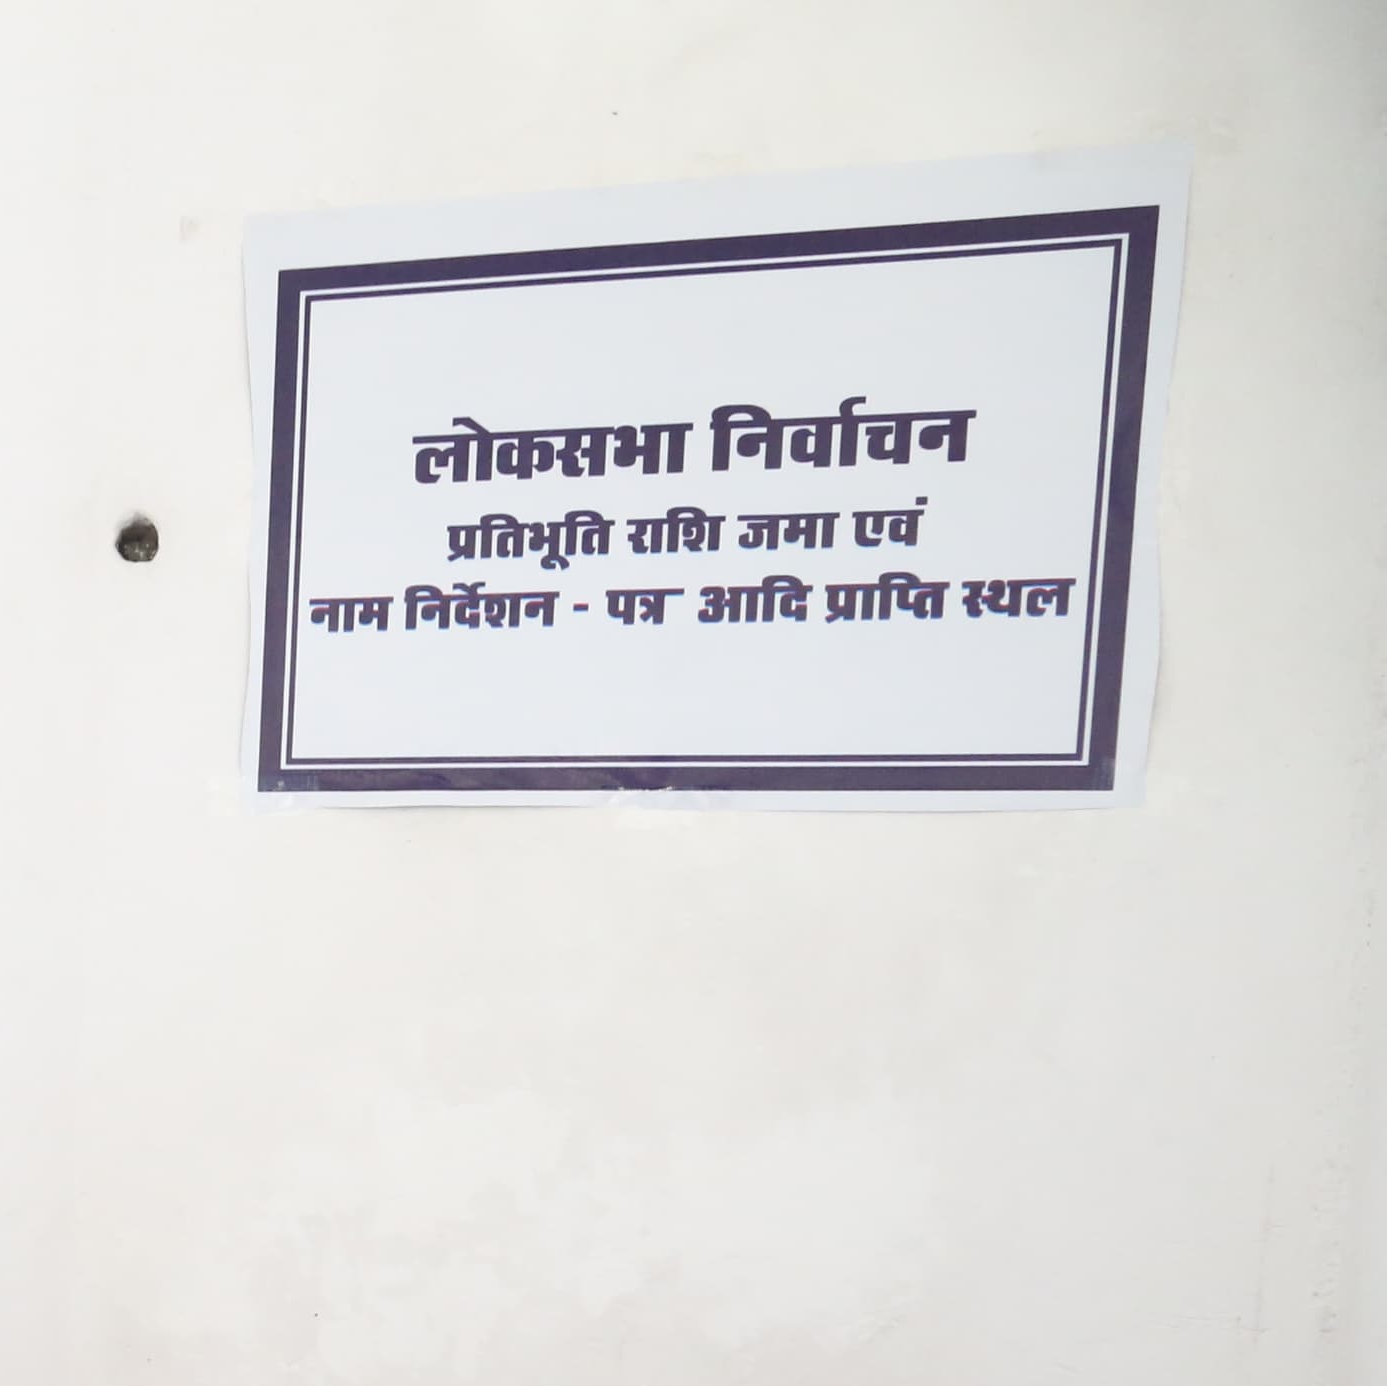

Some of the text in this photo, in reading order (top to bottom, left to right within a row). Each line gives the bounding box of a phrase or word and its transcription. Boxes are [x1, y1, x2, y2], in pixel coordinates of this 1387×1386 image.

[413, 397, 976, 483] लोकसभा निर्वाचन
[447, 497, 927, 570] प्रतिभूति राशि जमा एवं
[310, 597, 393, 632] नाम
[405, 582, 559, 629] निर्देशन
[606, 589, 684, 624] पत्र
[698, 575, 813, 622] आदि
[825, 572, 950, 623] प्राप्ति
[962, 578, 1076, 617] स्थल
